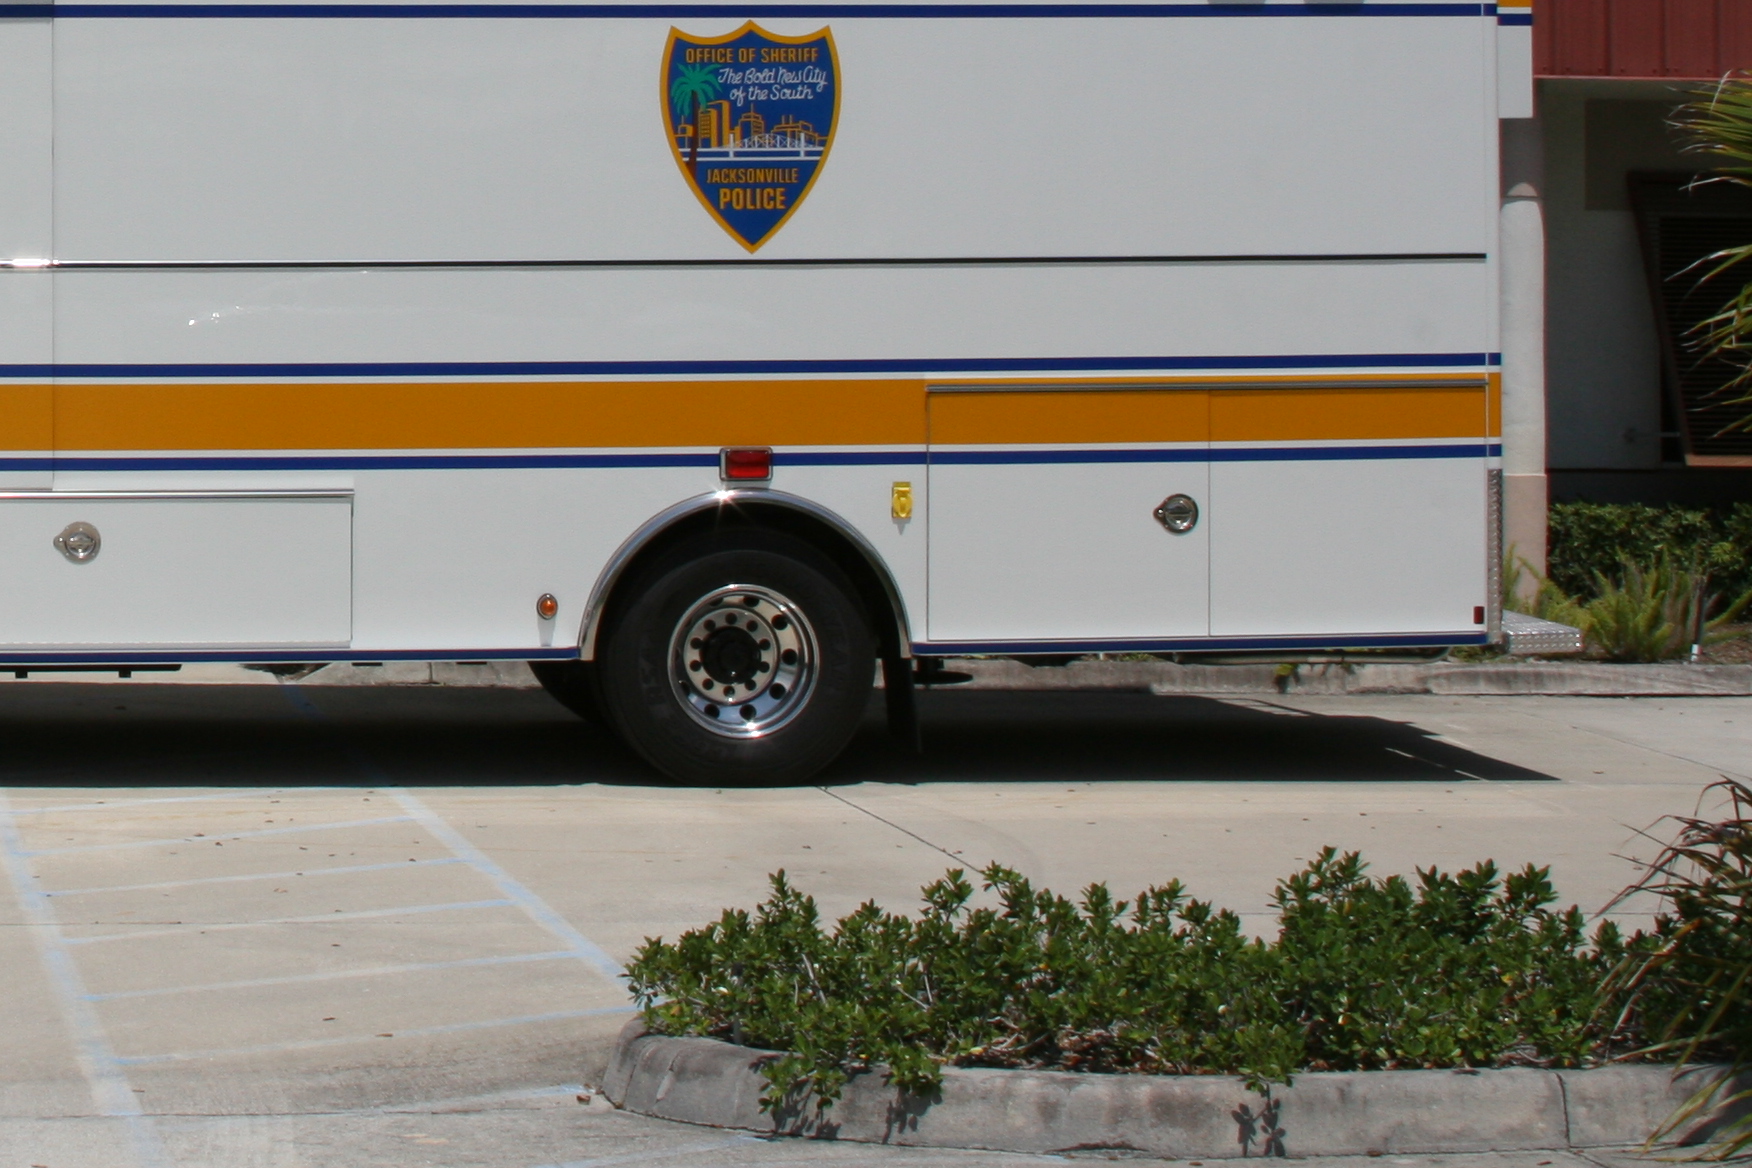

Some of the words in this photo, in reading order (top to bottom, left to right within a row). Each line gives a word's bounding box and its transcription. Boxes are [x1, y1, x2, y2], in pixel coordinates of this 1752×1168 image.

[685, 47, 734, 63] OFFICE
[738, 47, 756, 63] OF
[760, 47, 819, 63] SHERIFF
[717, 67, 742, 85] The
[744, 67, 775, 85] Bold
[777, 66, 802, 85] New
[803, 65, 828, 92] City
[729, 88, 746, 107] of
[748, 86, 769, 101] the
[769, 84, 814, 101] South
[706, 168, 799, 184] JACKSONVILLE
[719, 188, 787, 210] POLICE
